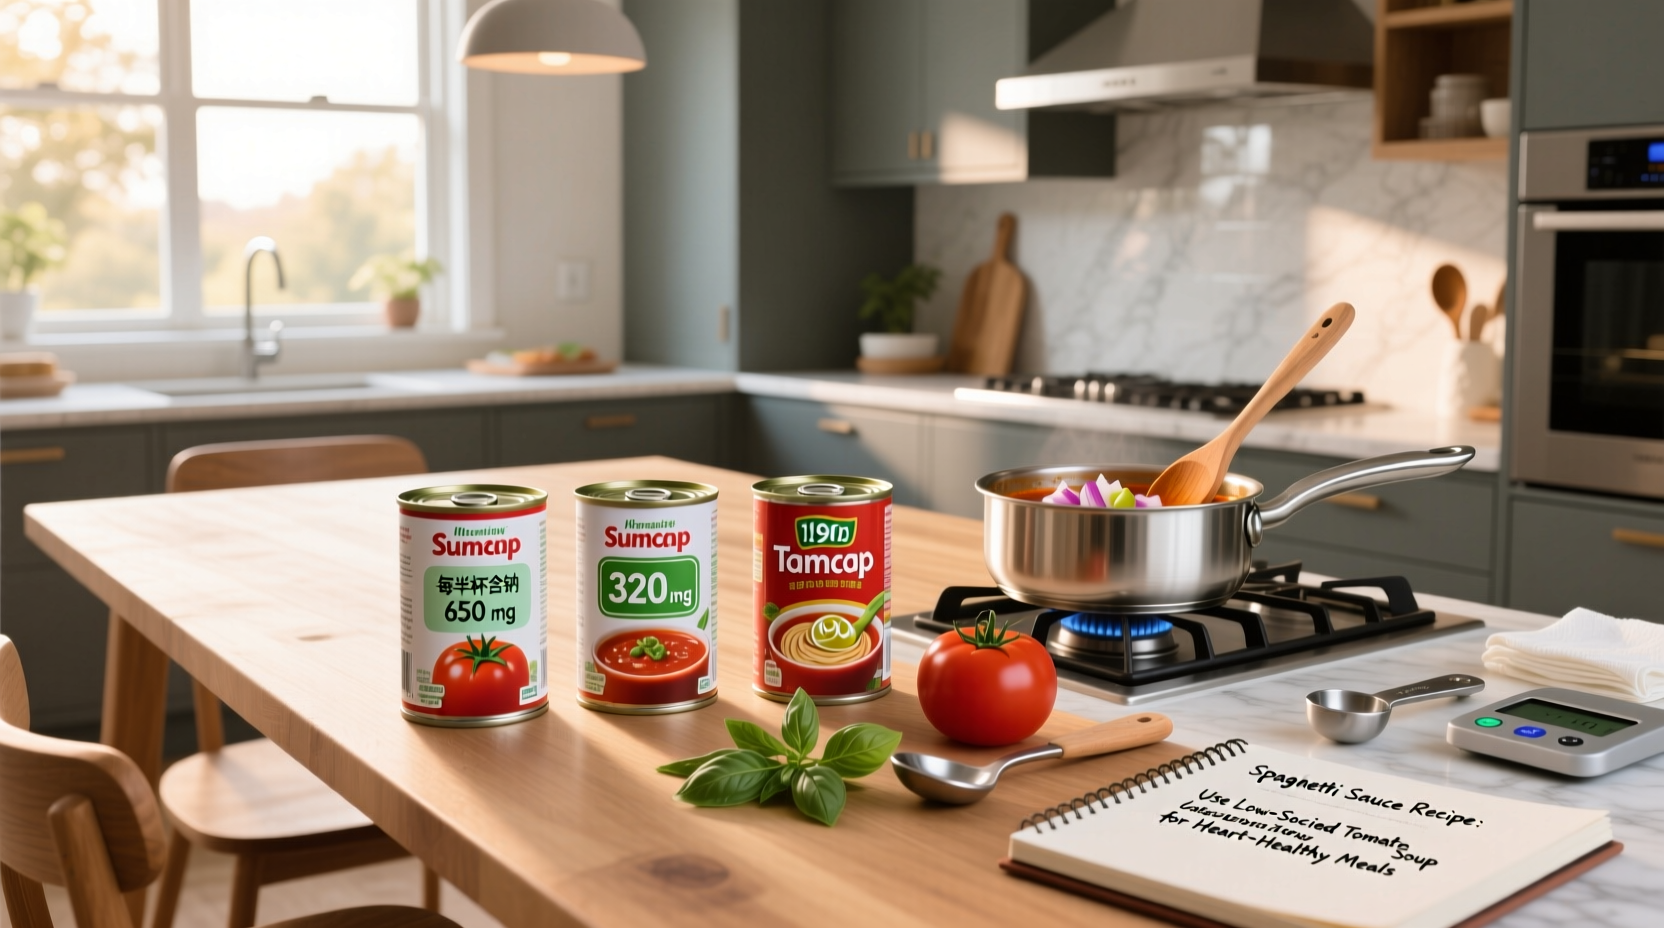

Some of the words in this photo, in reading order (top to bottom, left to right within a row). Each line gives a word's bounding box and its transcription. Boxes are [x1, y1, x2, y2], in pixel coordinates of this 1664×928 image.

[773, 544, 874, 579] Tamcap
[608, 571, 668, 604] 320
[444, 600, 486, 622] 650
[491, 606, 516, 625] mg
[1199, 789, 1231, 806] Use
[1344, 788, 1403, 811] Sauce
[1409, 802, 1484, 828] Recipe:
[1159, 811, 1190, 824] for
[1334, 853, 1396, 876] Meals
[1390, 849, 1438, 871] Soup
